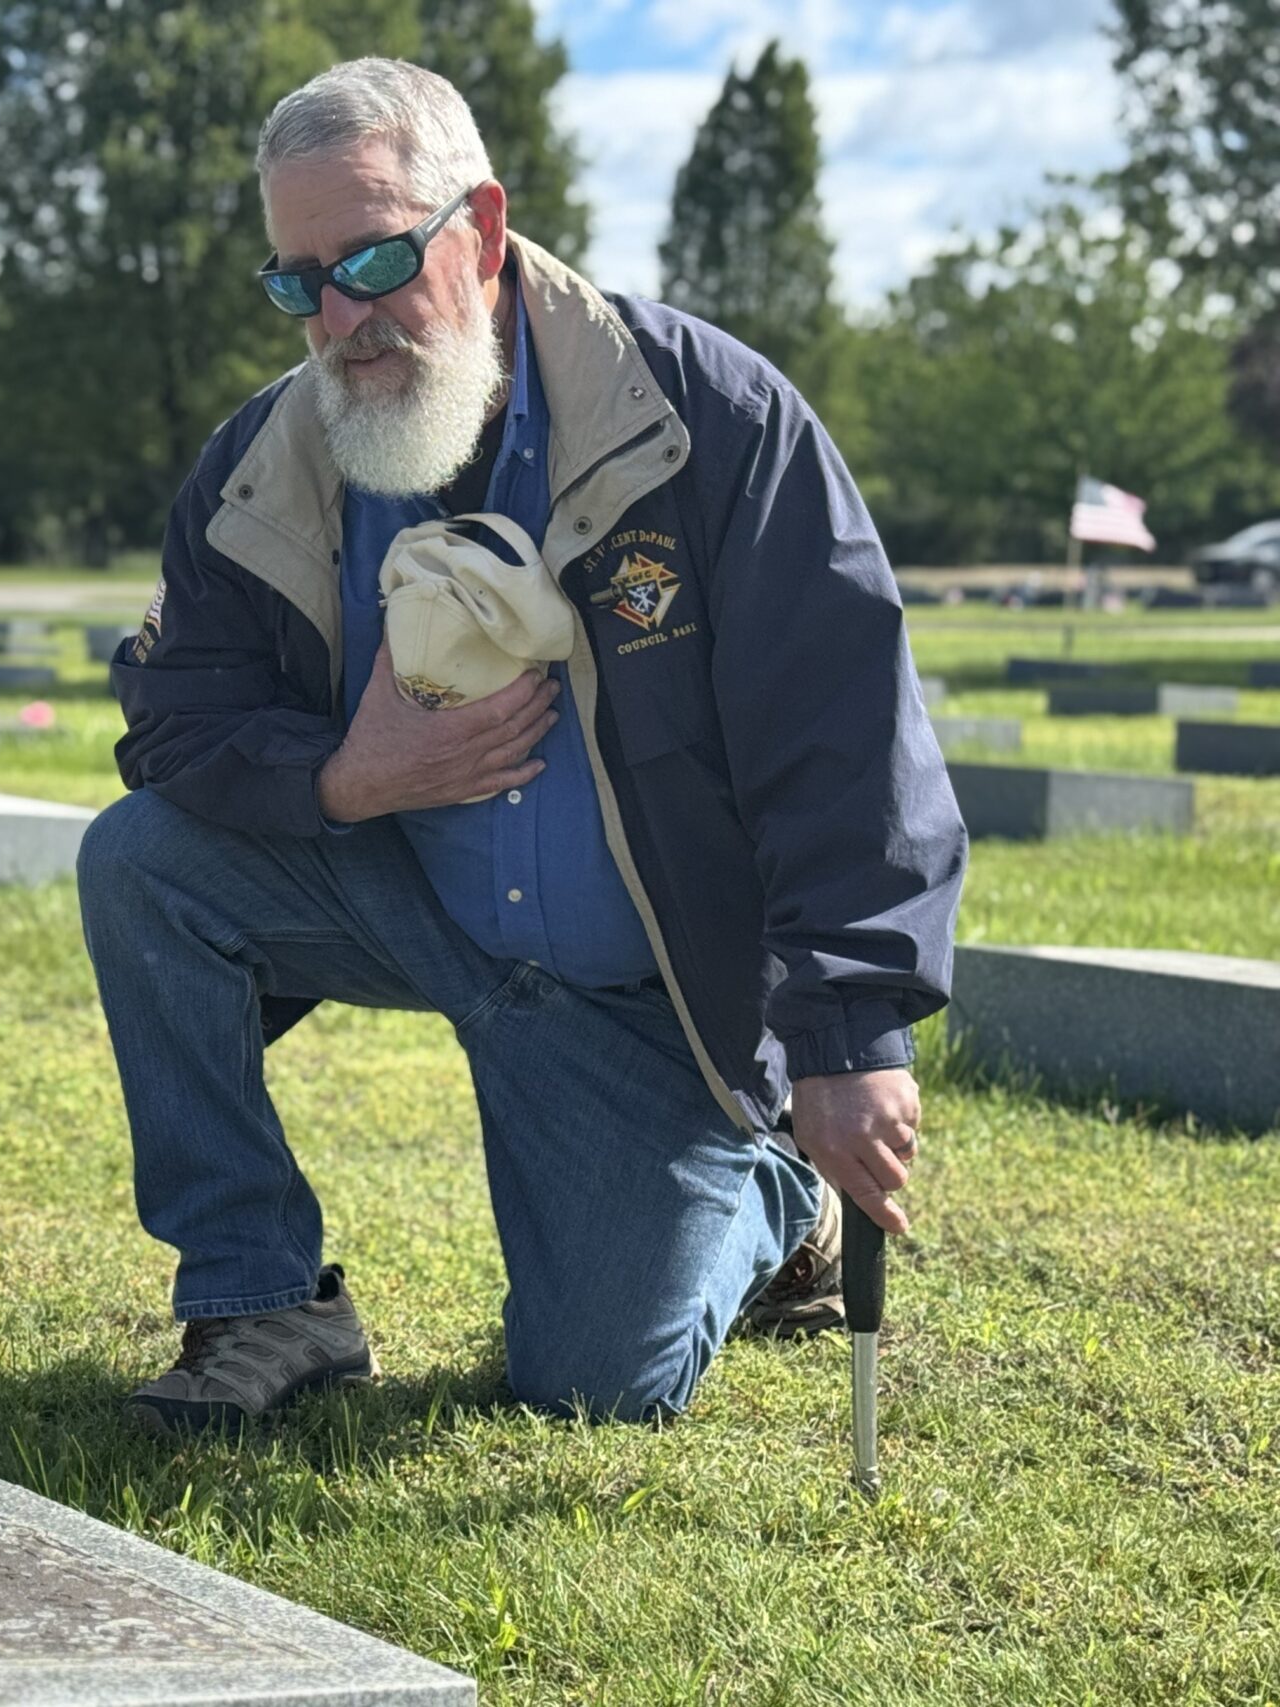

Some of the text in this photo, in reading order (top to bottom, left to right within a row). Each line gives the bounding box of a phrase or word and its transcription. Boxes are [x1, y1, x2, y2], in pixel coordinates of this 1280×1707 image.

[583, 556, 600, 574] ST.
[639, 530, 676, 550] DePAUL
[617, 632, 668, 656] COUNCIL
